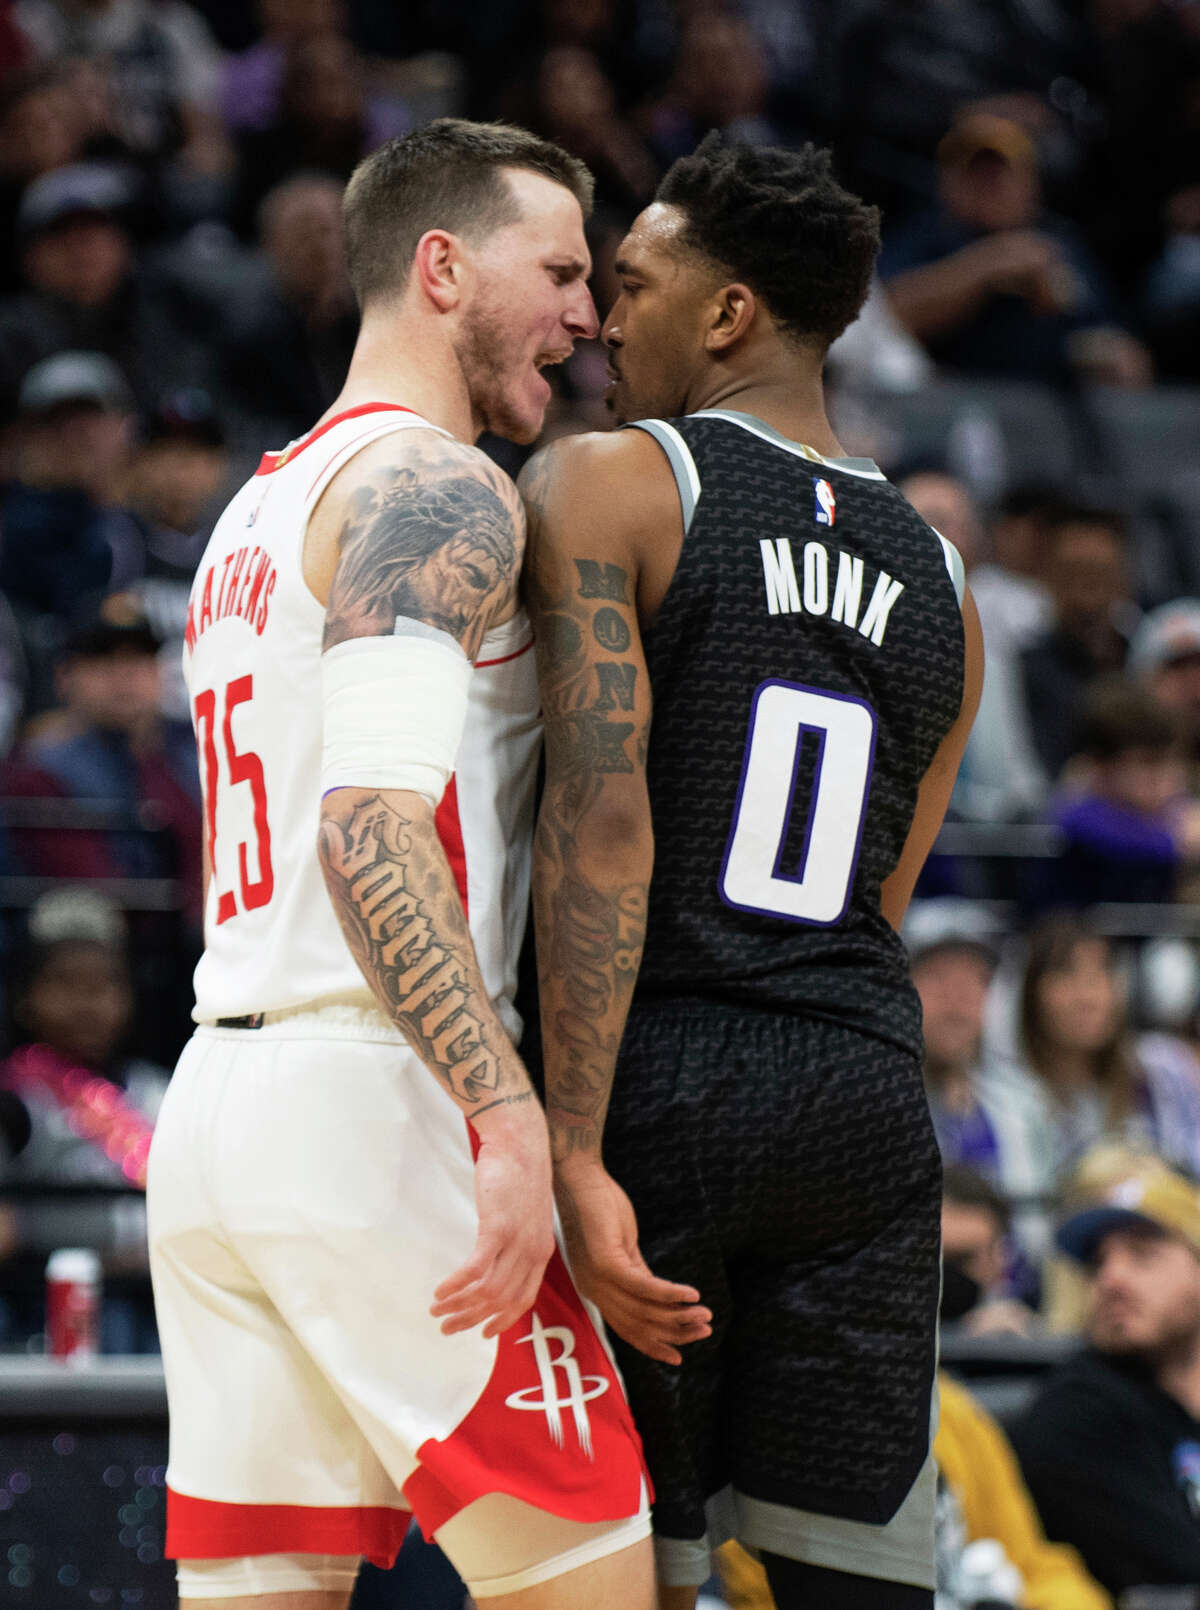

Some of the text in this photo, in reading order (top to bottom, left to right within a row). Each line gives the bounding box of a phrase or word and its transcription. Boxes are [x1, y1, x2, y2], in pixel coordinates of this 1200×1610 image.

[759, 537, 905, 647] MONK
[717, 678, 878, 928] 0
[320, 794, 501, 1103] Sacrifice
